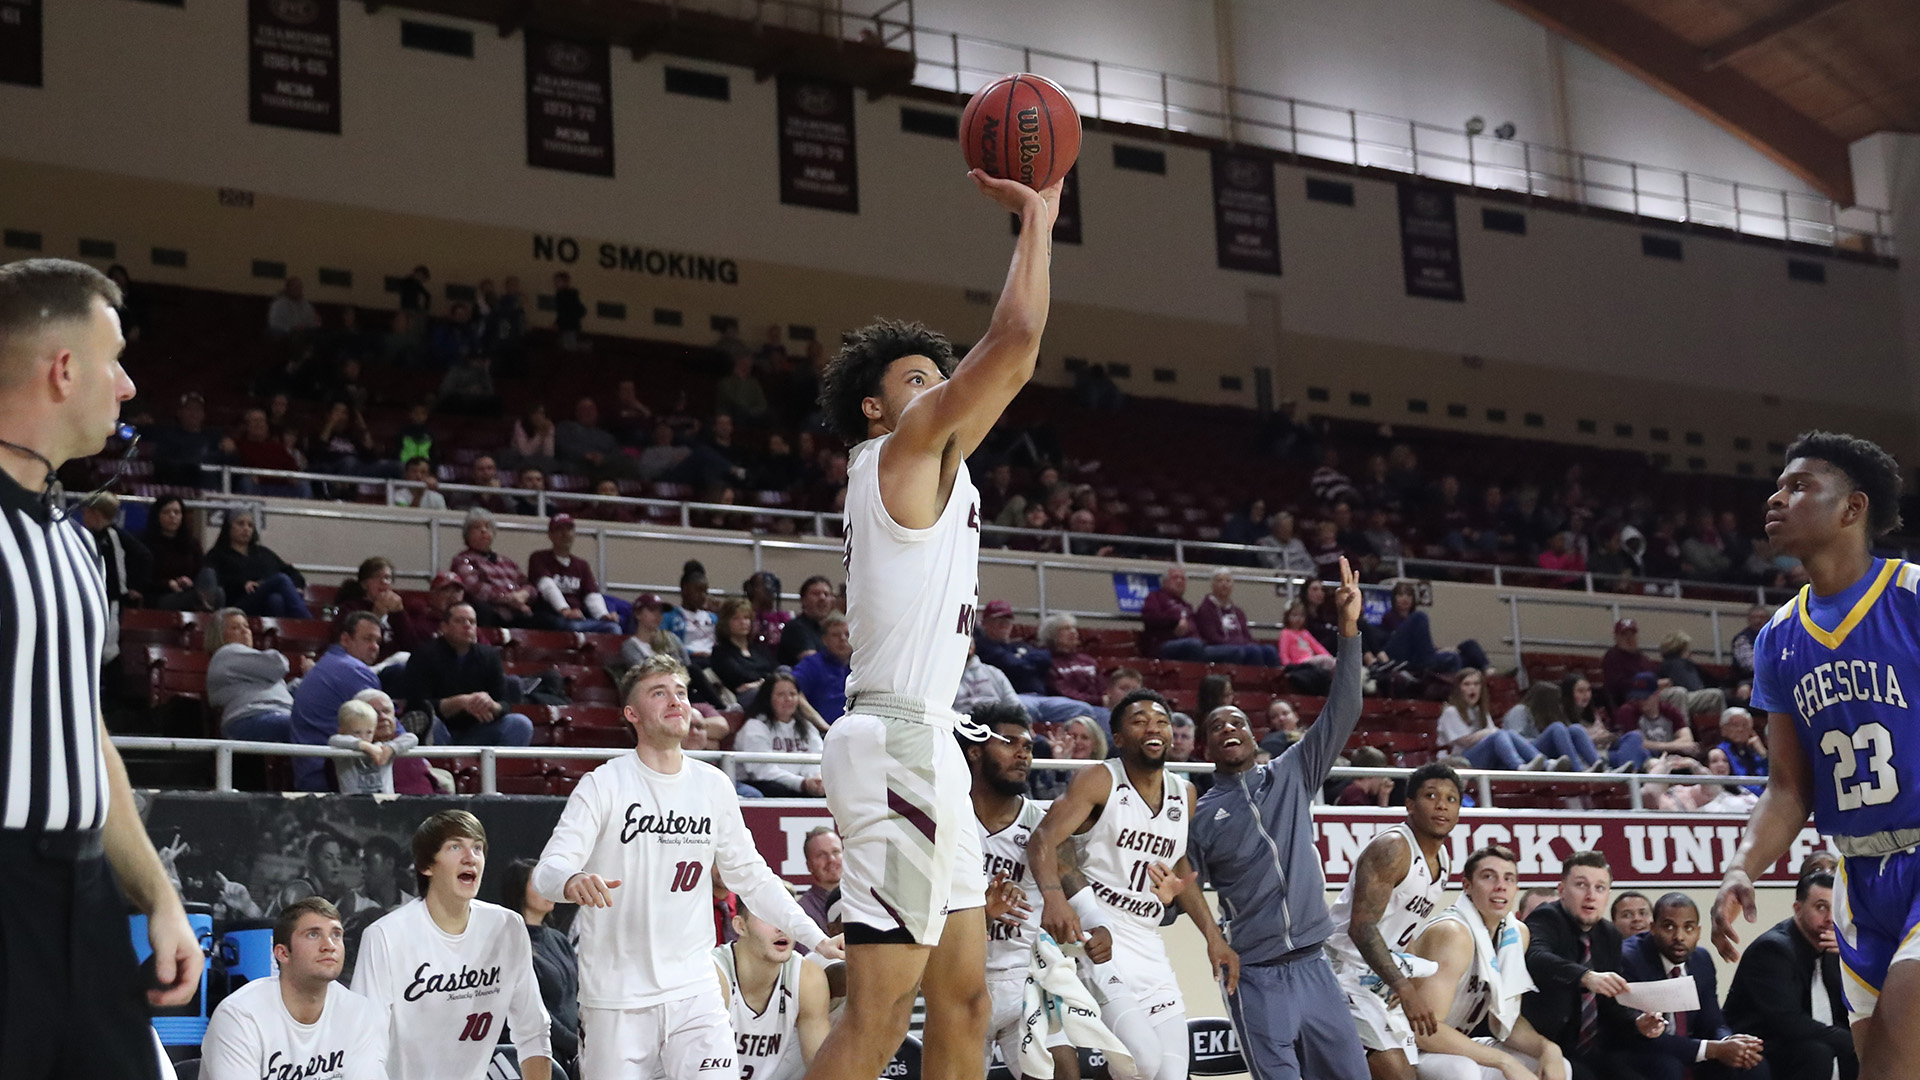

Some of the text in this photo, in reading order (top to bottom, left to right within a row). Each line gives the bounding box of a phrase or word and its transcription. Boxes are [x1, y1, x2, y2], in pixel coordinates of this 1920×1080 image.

[1018, 106, 1041, 185] Wilson
[534, 236, 738, 285] NO SMOKING
[1819, 721, 1901, 812] 23
[621, 803, 711, 844] Eastern
[1116, 828, 1177, 858] EASTERN
[671, 861, 703, 892] 10
[1128, 860, 1149, 892] 11
[404, 962, 500, 1002] Eastern
[459, 1012, 493, 1041] 10
[734, 1031, 782, 1057] STERN
[700, 1058, 732, 1071] EKU
